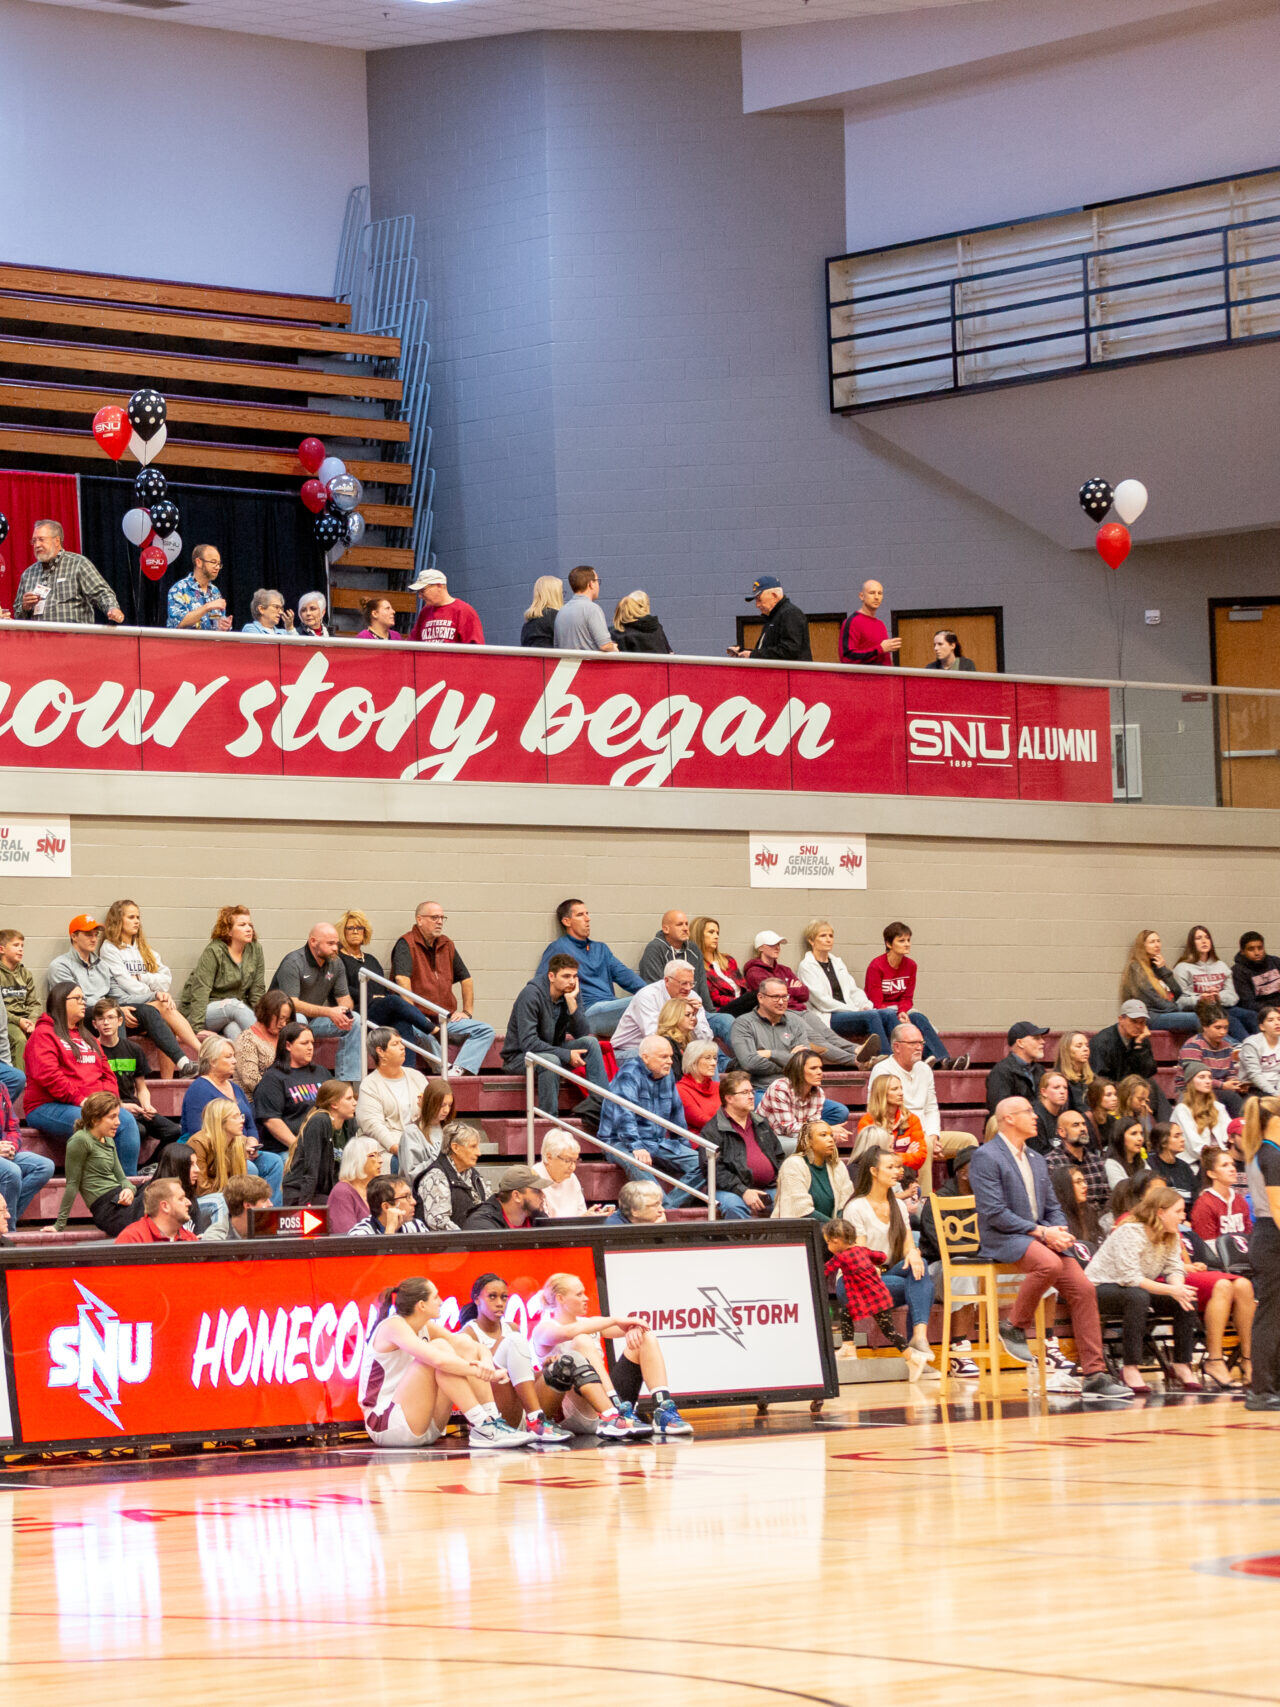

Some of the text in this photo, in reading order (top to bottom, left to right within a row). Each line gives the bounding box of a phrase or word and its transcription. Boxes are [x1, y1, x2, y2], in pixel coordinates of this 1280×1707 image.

[224, 651, 499, 781] story
[519, 658, 836, 788] began
[908, 719, 1098, 762] SNU ALUMNI
[949, 759, 973, 768] 1899
[35, 834, 66, 857] SNU
[800, 845, 819, 856] SNU
[754, 850, 779, 870] SNU
[788, 854, 830, 866] GENERAL
[839, 851, 863, 871] SNU
[784, 865, 835, 877] ADMISSION
[731, 1303, 799, 1326] STORM
[47, 1308, 153, 1398] SNU
[191, 1300, 400, 1390] HOMECO
